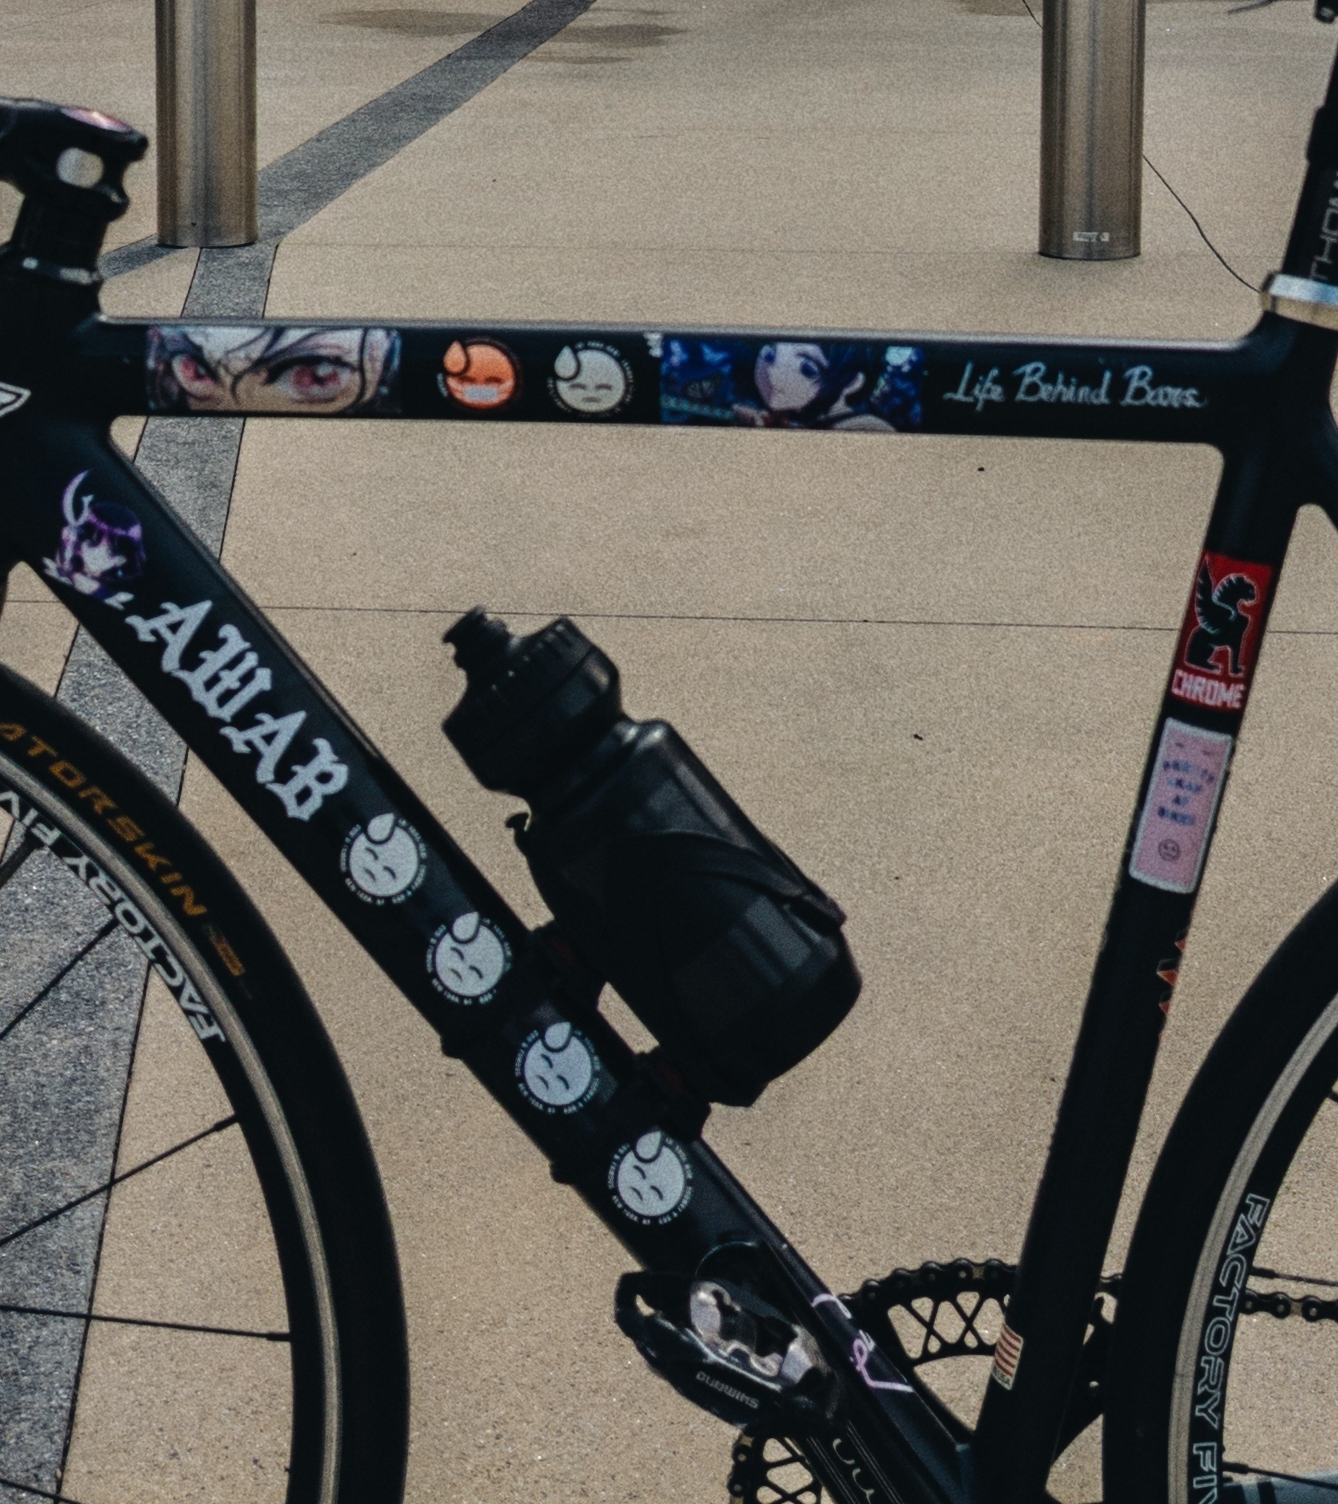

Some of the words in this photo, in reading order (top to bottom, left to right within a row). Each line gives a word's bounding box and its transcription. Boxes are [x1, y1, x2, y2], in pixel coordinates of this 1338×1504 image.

[943, 361, 1005, 412] Life
[1013, 360, 1111, 406] Behind
[1171, 669, 1245, 709] CHROME
[61, 852, 226, 1045] FACTORY
[1194, 1192, 1270, 1431] FACTORY
